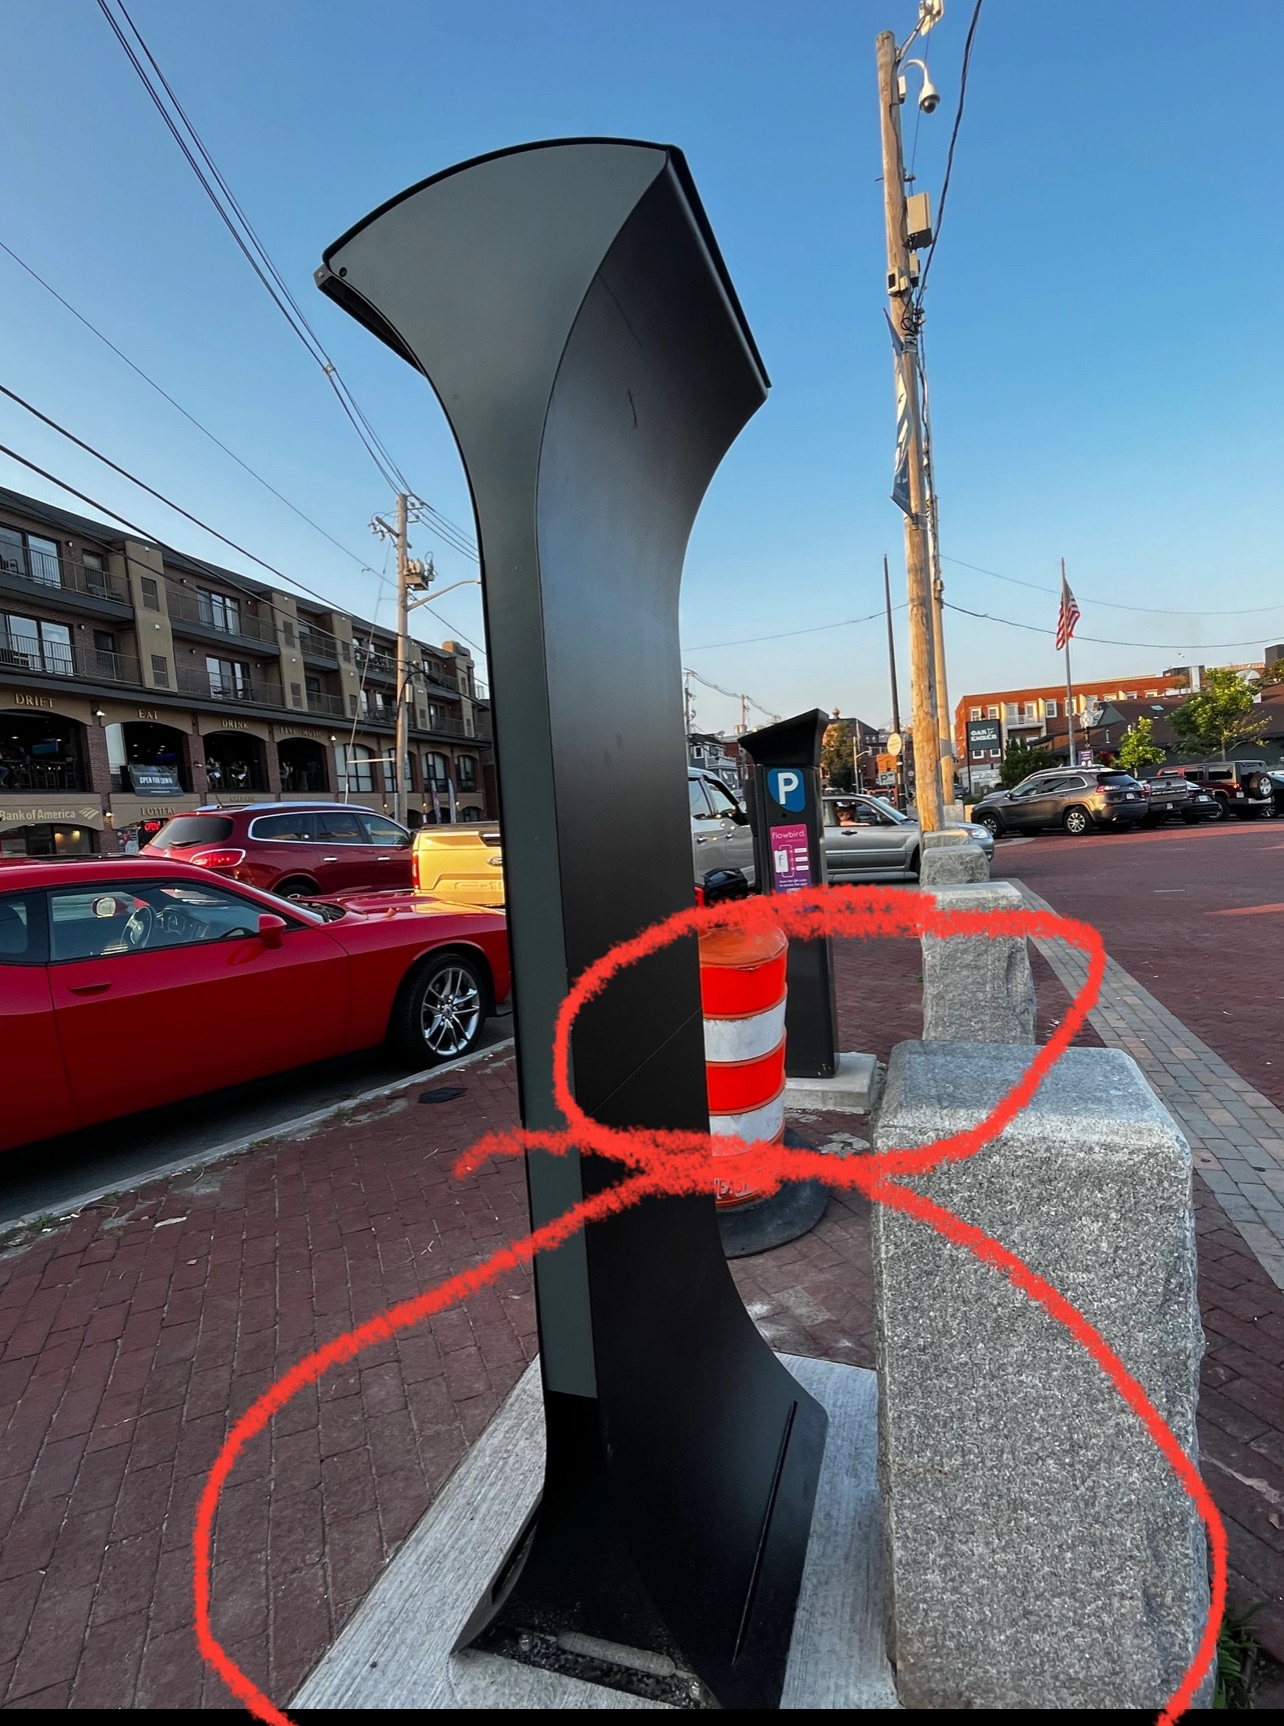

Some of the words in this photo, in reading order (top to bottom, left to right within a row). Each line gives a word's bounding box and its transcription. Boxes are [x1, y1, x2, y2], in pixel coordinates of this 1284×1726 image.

[15, 693, 55, 708] DRIFT
[138, 708, 159, 720] EAT
[222, 718, 249, 730] DRINK
[280, 726, 298, 735] LIVE
[302, 728, 322, 737] MUSIC
[777, 772, 799, 805] P
[0, 810, 25, 821] Bank
[26, 809, 36, 820] of
[37, 809, 76, 820] America
[140, 807, 176, 816] LOTTERY
